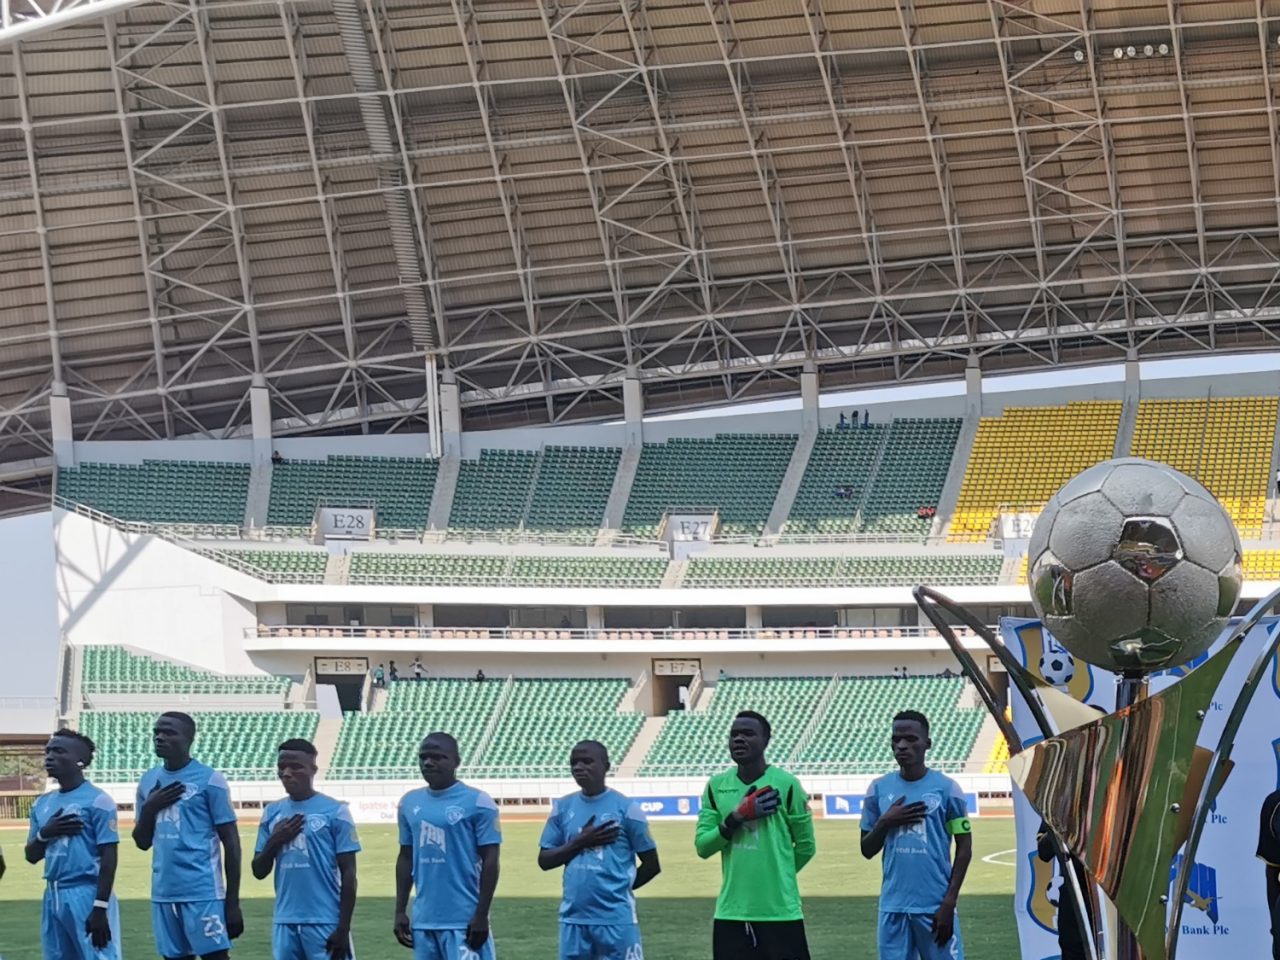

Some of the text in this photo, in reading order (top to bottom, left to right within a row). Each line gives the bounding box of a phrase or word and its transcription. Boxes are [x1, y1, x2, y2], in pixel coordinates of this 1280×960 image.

[332, 513, 366, 529] E28
[680, 520, 709, 536] E27
[335, 661, 351, 672] E8
[670, 662, 685, 674] E7
[641, 802, 664, 812] CUP
[1211, 812, 1228, 823] Plc
[1182, 924, 1230, 935] Bank Plc
